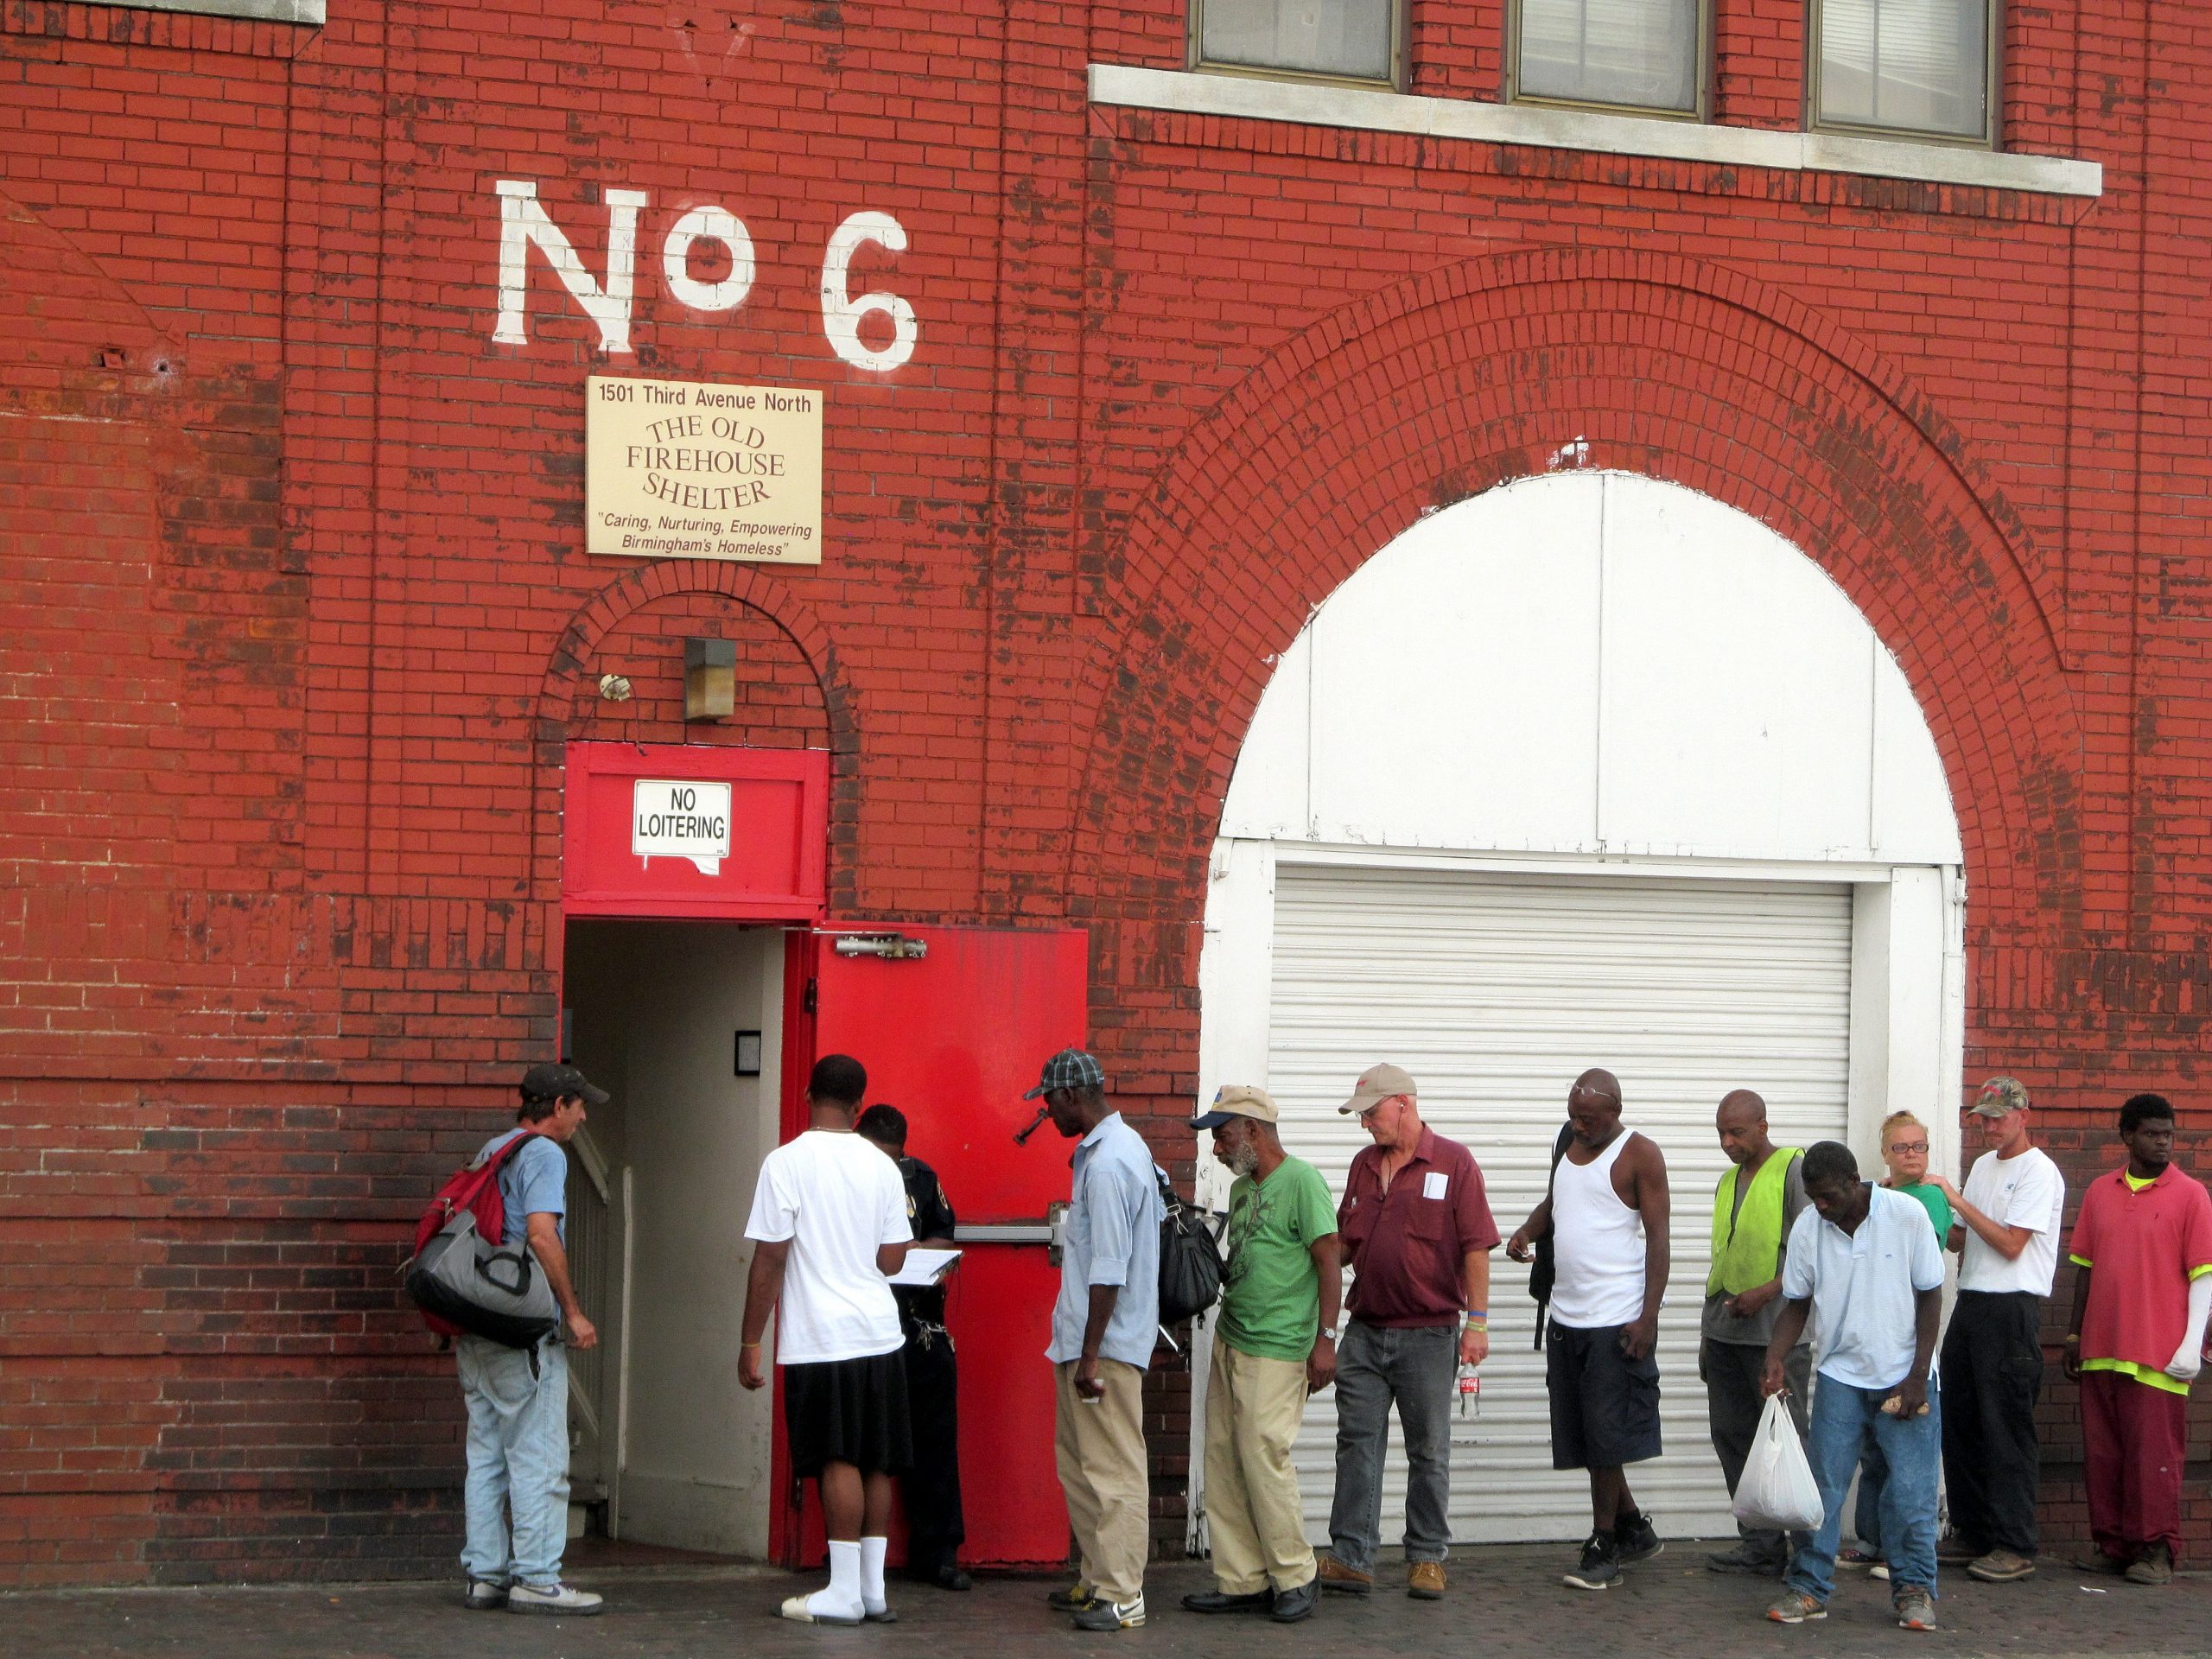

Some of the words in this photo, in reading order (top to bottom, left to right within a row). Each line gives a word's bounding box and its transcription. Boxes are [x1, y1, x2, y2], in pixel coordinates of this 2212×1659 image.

[492, 180, 756, 353] No
[821, 211, 918, 373] 6
[599, 384, 633, 403] 1501
[643, 385, 686, 405] Third
[695, 388, 756, 410] Avenue
[765, 392, 811, 413] North
[646, 415, 703, 444] THE
[712, 416, 765, 449] OLD
[626, 445, 785, 477] FIREHOUSE
[642, 472, 771, 510] SHELTER
[658, 516, 724, 536] Nurturing,
[730, 519, 812, 541] Empowering
[621, 534, 712, 554] Birmingham's
[717, 539, 789, 556] Homeless"
[671, 788, 696, 811] NO
[639, 813, 725, 840] LOITERING
